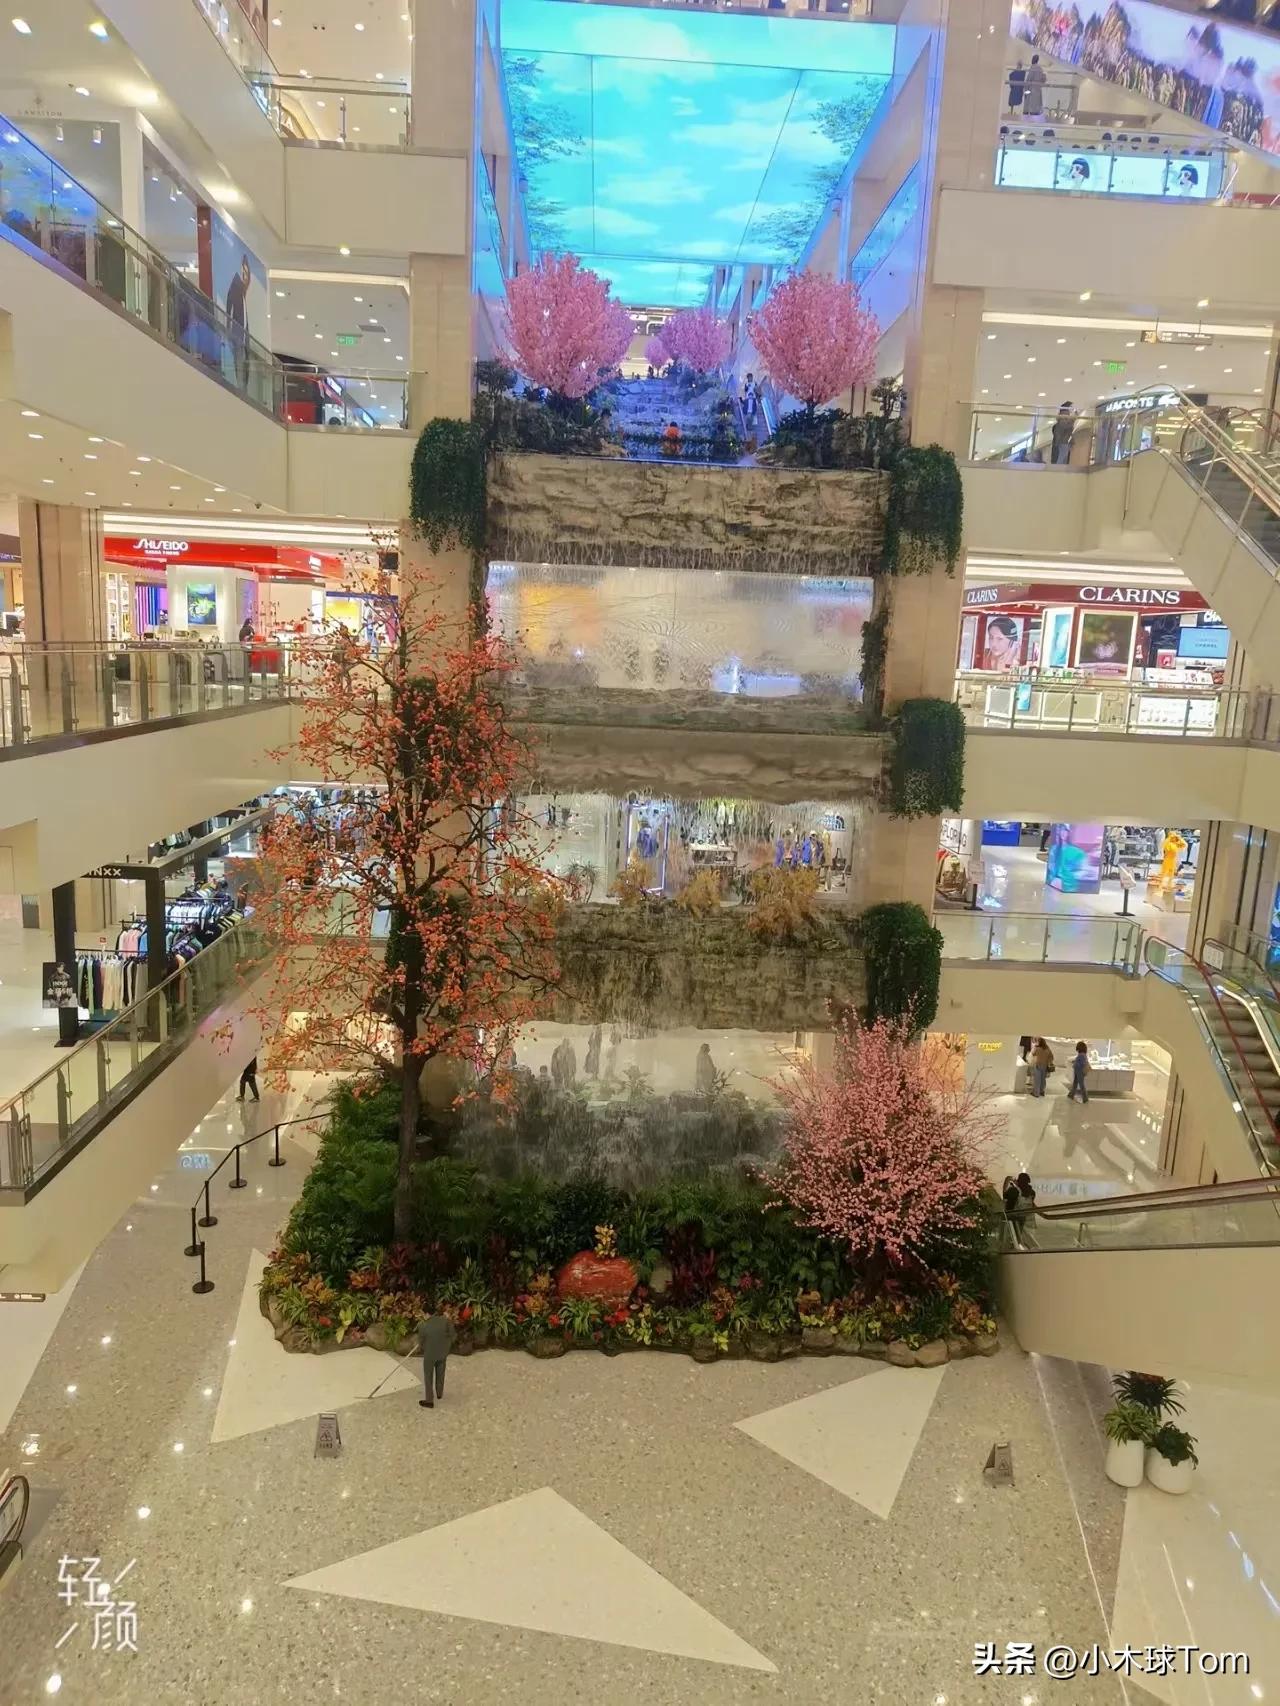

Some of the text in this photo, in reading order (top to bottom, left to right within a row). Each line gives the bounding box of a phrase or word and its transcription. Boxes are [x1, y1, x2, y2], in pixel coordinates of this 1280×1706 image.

[133, 539, 189, 550] SHISEIDO
[967, 588, 998, 603] CLARINS
[1079, 586, 1180, 605] CLARINS
